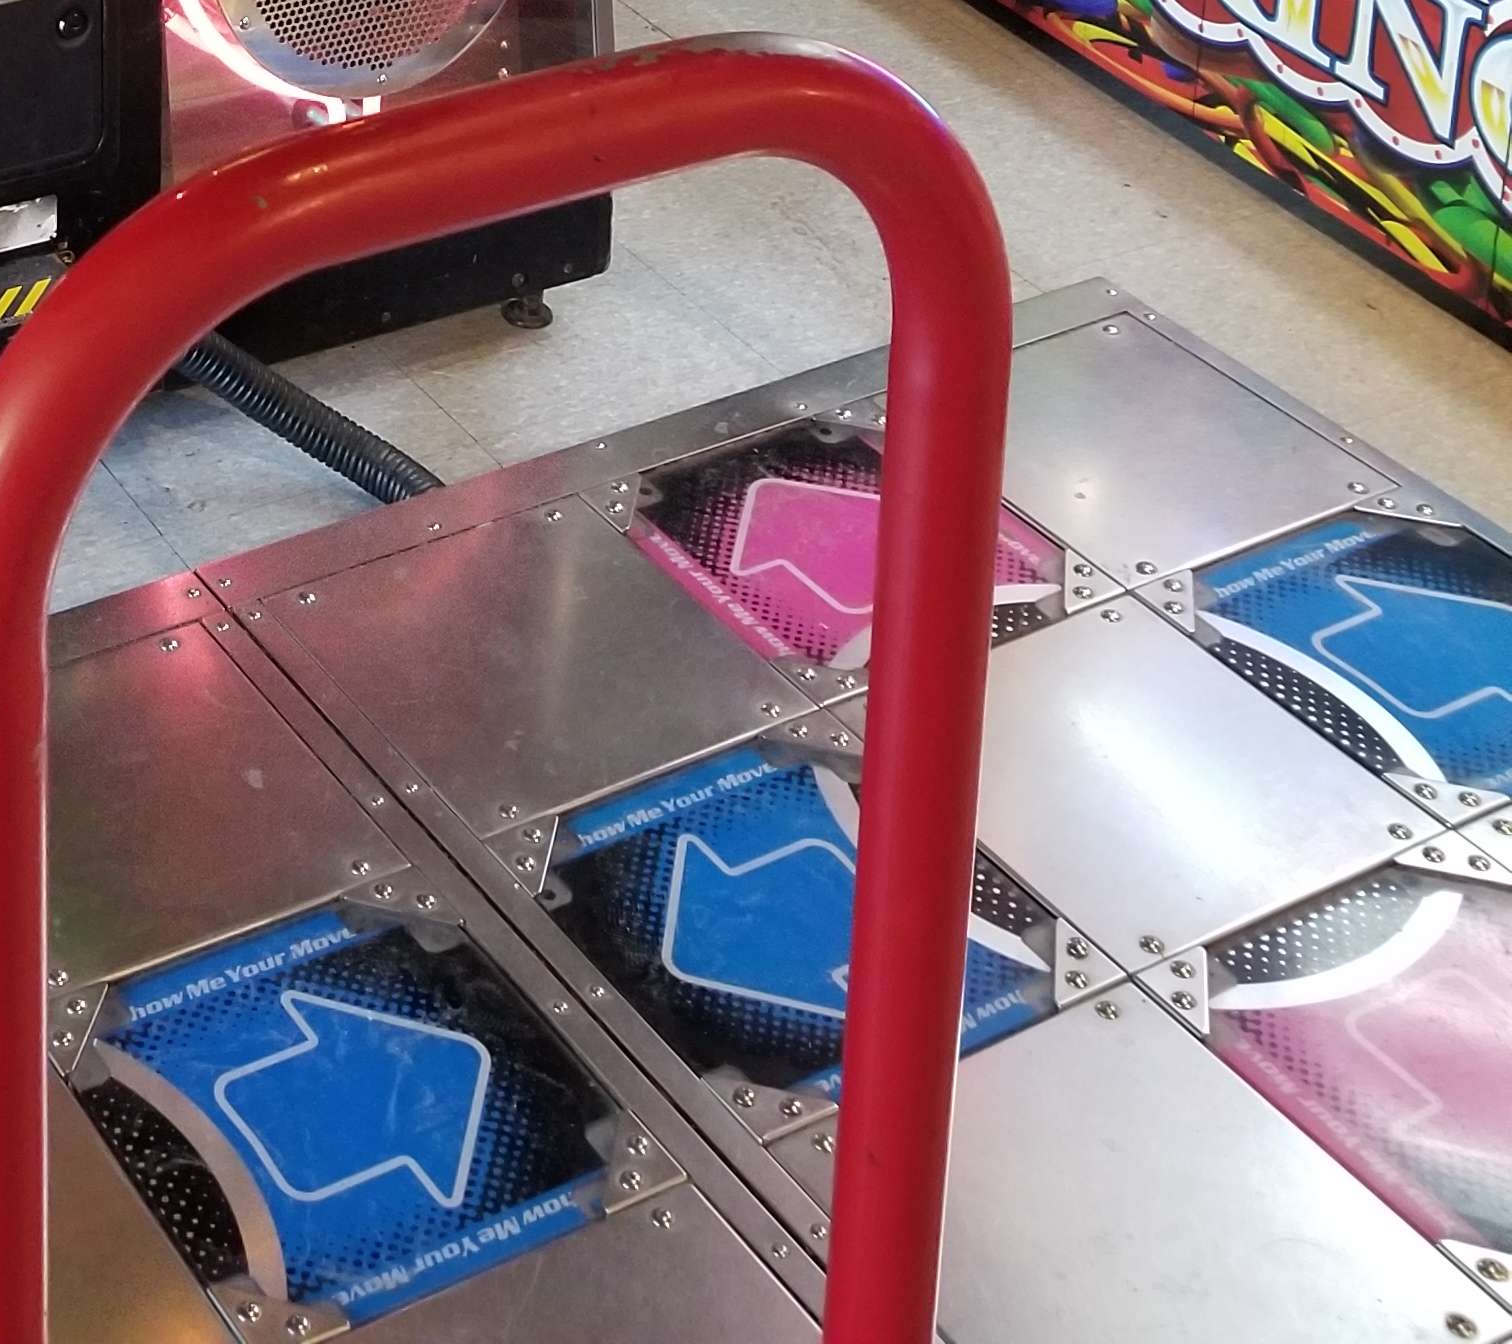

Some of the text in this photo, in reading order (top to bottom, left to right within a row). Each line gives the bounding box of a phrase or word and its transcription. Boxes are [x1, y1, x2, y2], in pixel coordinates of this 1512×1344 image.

[1213, 577, 1256, 599] how
[577, 819, 627, 848] how
[626, 805, 665, 829] Me
[659, 783, 716, 814] Your
[128, 991, 184, 1022] how
[185, 975, 227, 1001] Me
[223, 951, 286, 984] Your
[522, 1192, 580, 1227] how
[476, 1215, 521, 1245] Me
[412, 1236, 481, 1275] Your
